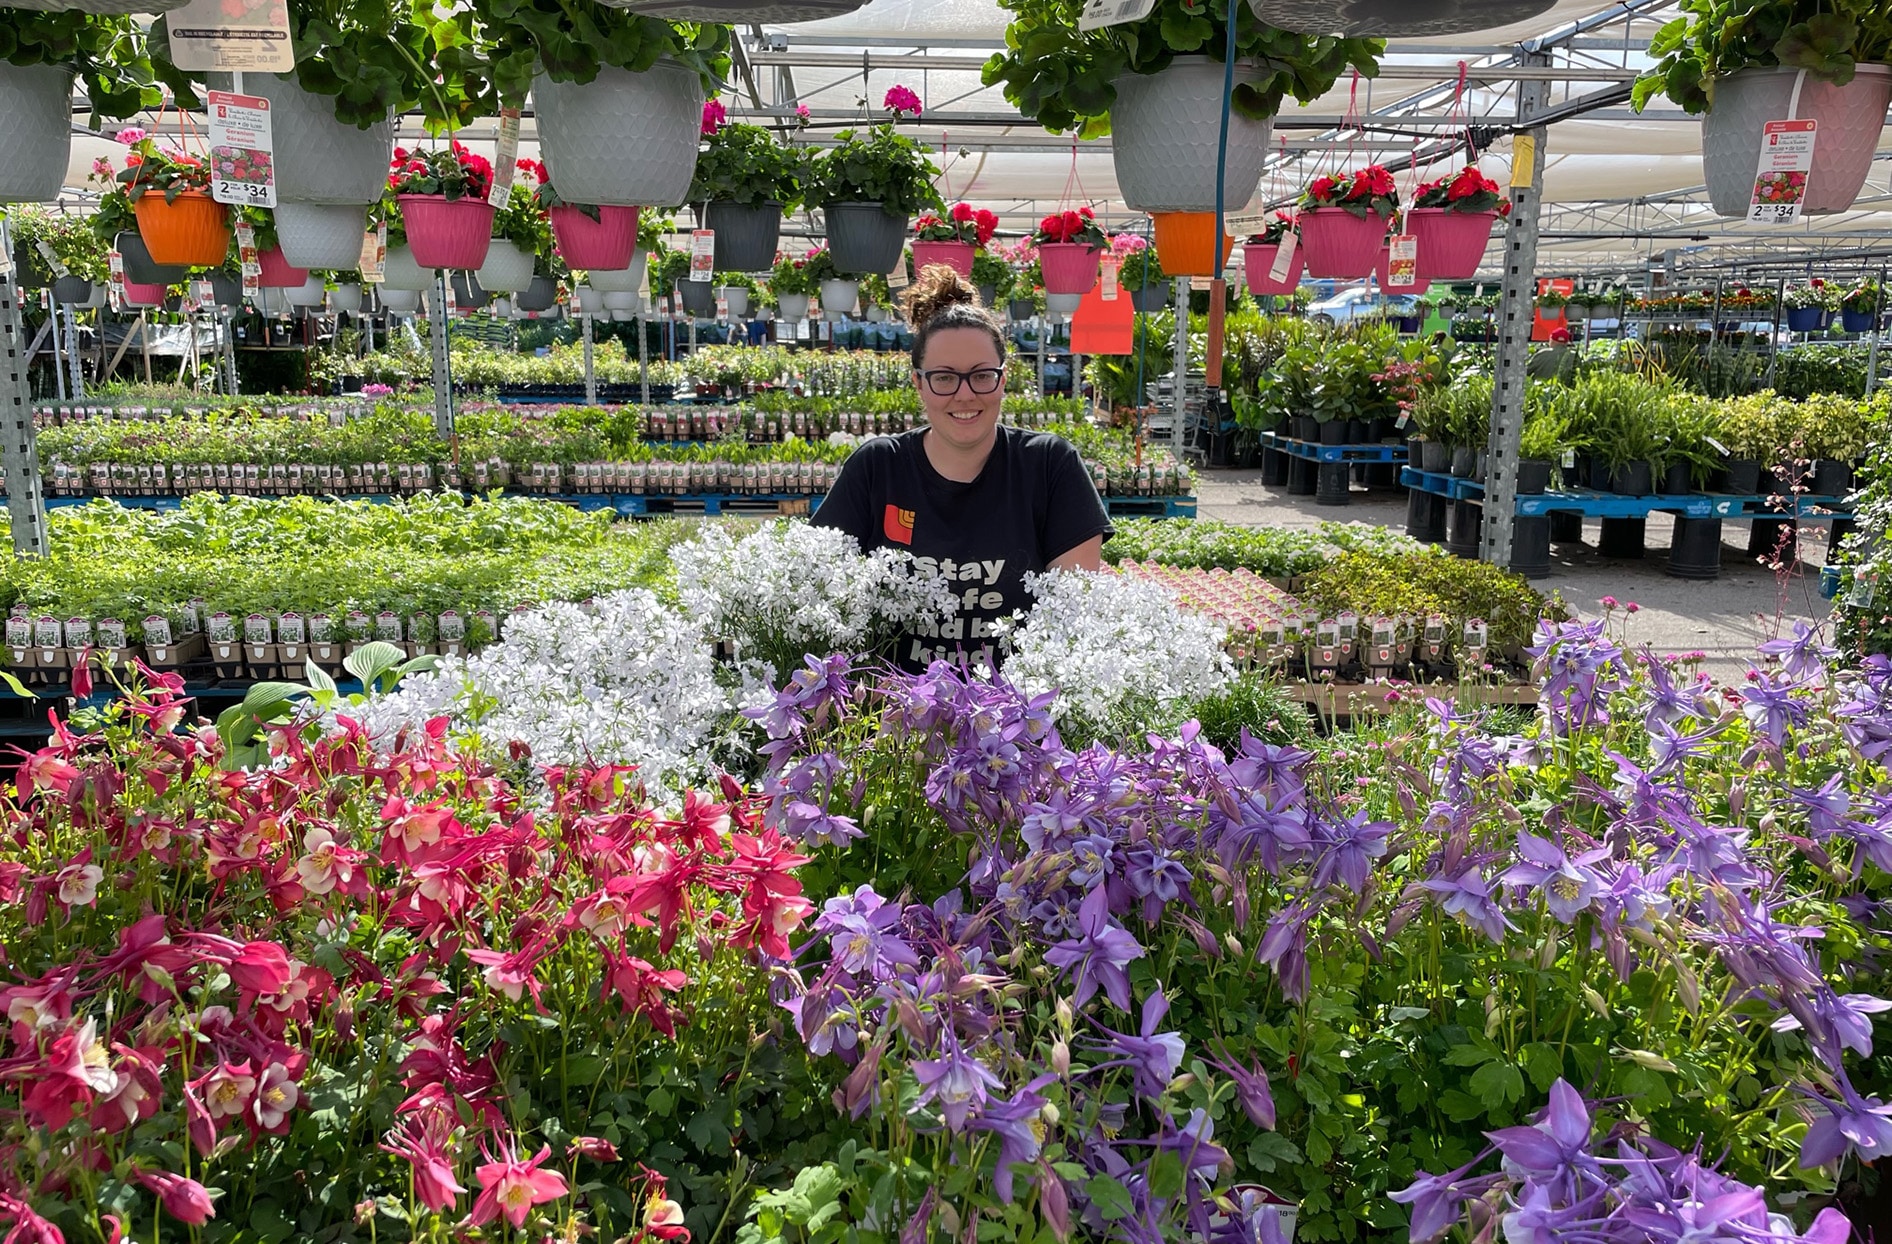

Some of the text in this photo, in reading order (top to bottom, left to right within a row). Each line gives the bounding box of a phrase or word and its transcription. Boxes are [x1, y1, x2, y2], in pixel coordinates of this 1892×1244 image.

[226, 128, 256, 137] Geranium
[220, 181, 230, 194] 2
[243, 183, 268, 198] $34
[1754, 205, 1763, 217] 2
[1774, 205, 1794, 217] $34
[912, 556, 1005, 585] Stay
[945, 588, 1004, 611] fe
[907, 617, 1017, 640] nd b
[909, 638, 995, 667] kind
